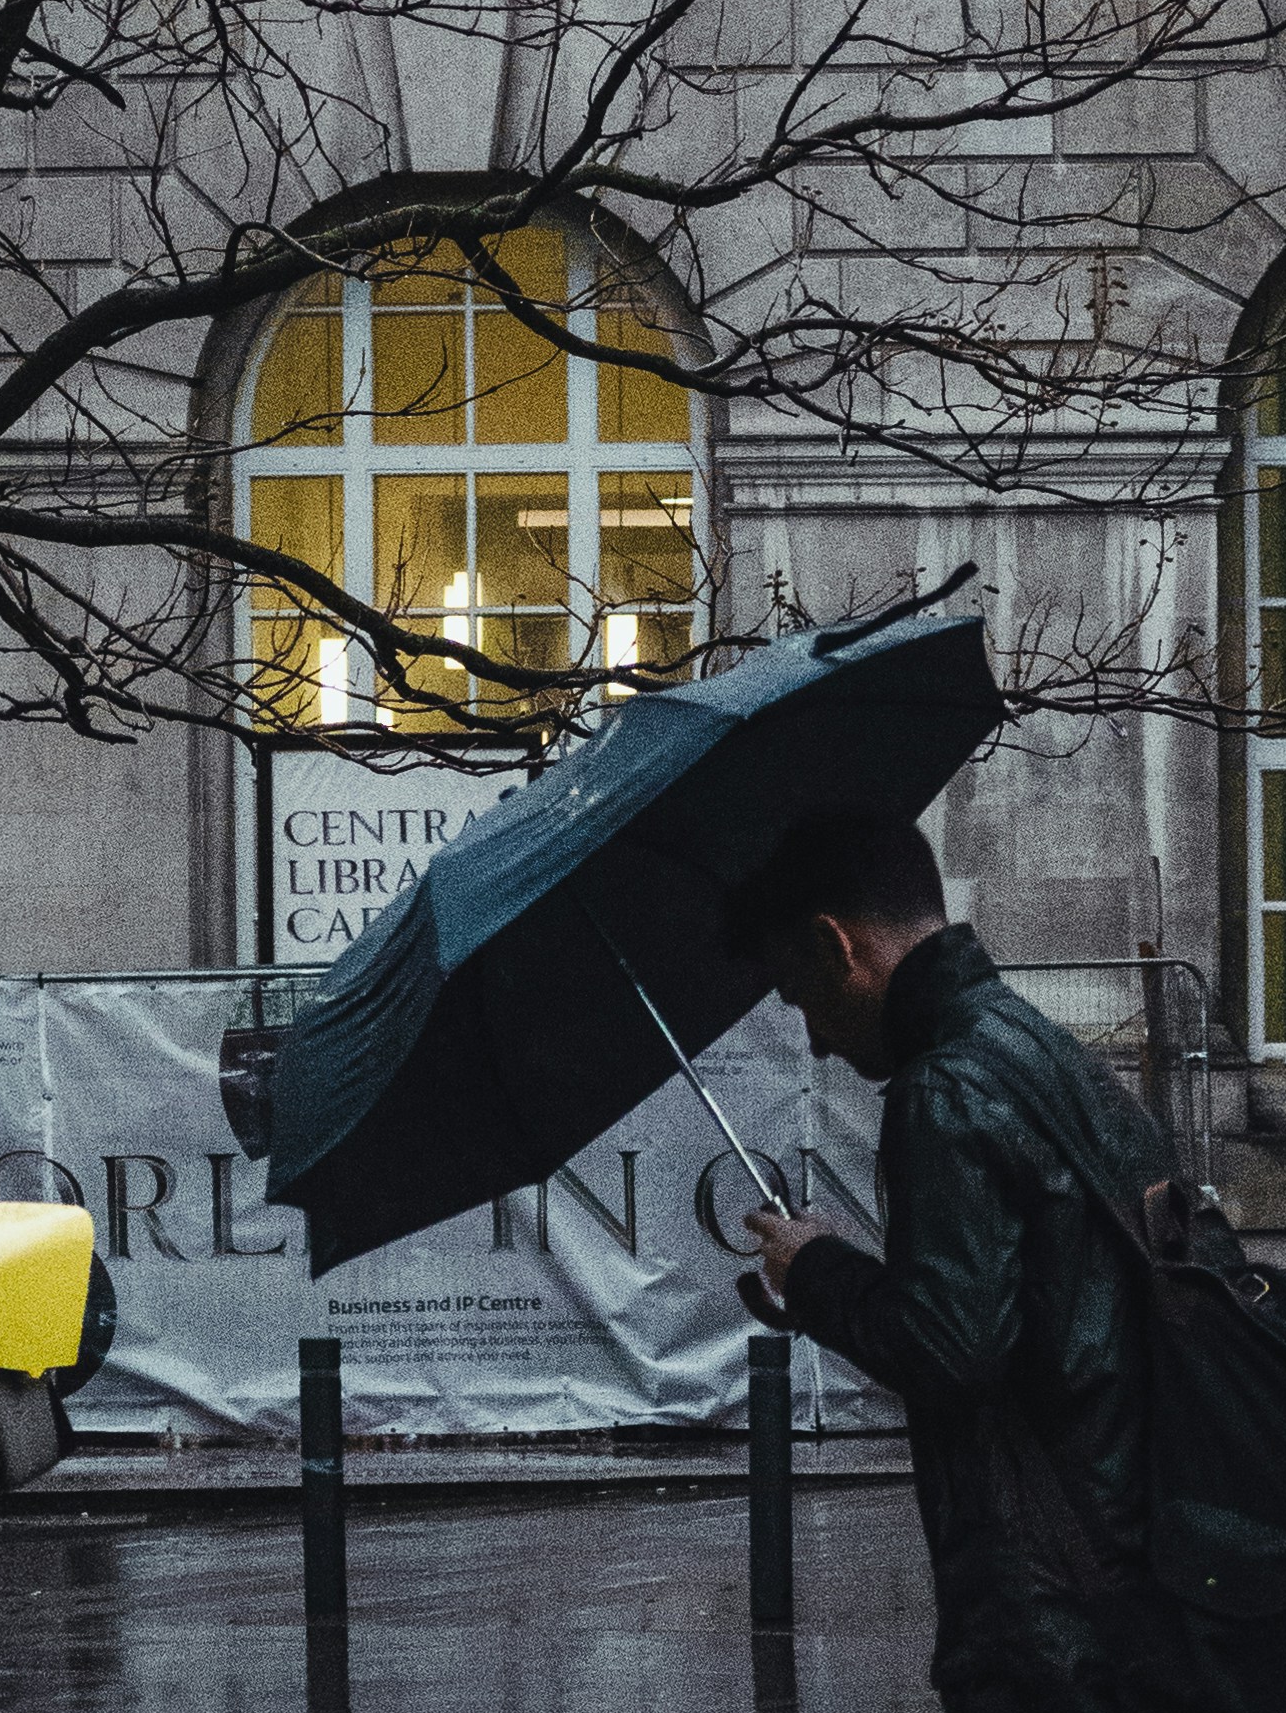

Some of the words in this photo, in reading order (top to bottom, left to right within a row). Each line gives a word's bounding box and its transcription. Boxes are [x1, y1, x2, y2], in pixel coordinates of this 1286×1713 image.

[283, 809, 477, 847] CENTR
[287, 858, 419, 895] LIBRA
[328, 1298, 411, 1314] Business
[415, 1296, 450, 1313] and
[456, 1296, 475, 1311] IP
[478, 1296, 542, 1312] Centre
